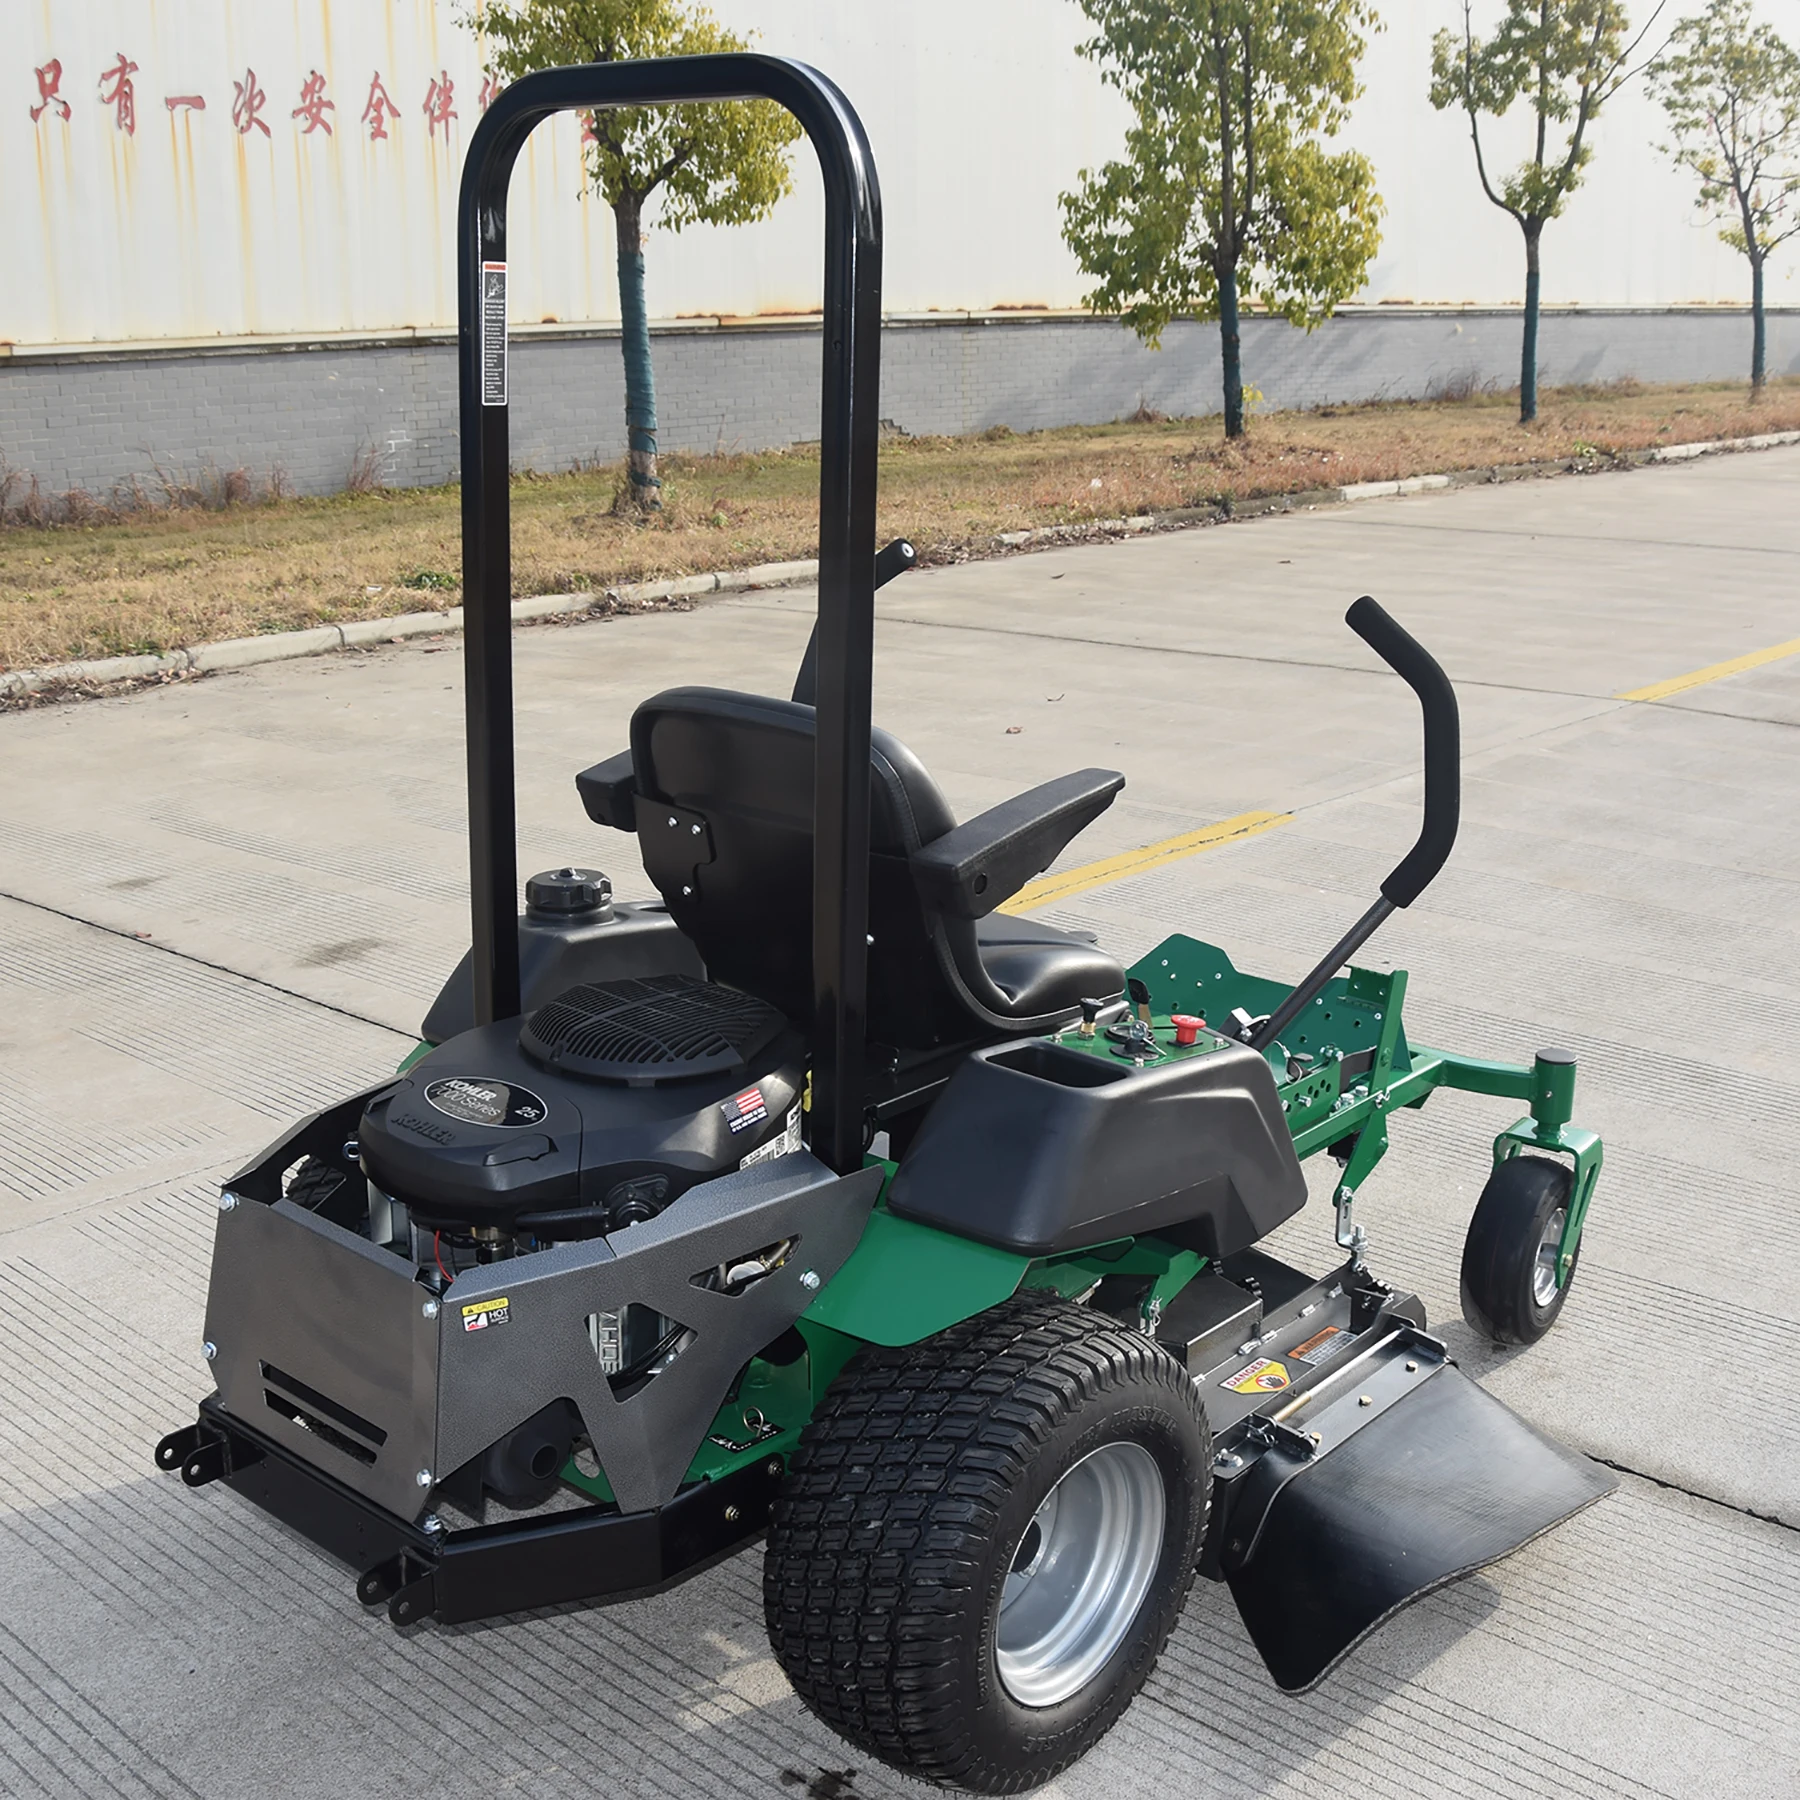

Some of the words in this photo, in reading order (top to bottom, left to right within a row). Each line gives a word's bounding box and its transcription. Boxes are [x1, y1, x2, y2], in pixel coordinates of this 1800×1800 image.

[431, 1084, 461, 1102] 7000
[460, 1094, 501, 1117] Series
[445, 1078, 497, 1101] KOHLER
[515, 1106, 540, 1119] 25
[391, 1114, 457, 1145] KOHLER
[477, 1299, 506, 1311] CAUTION
[489, 1307, 508, 1319] HOT
[1226, 1360, 1267, 1387] DANGER
